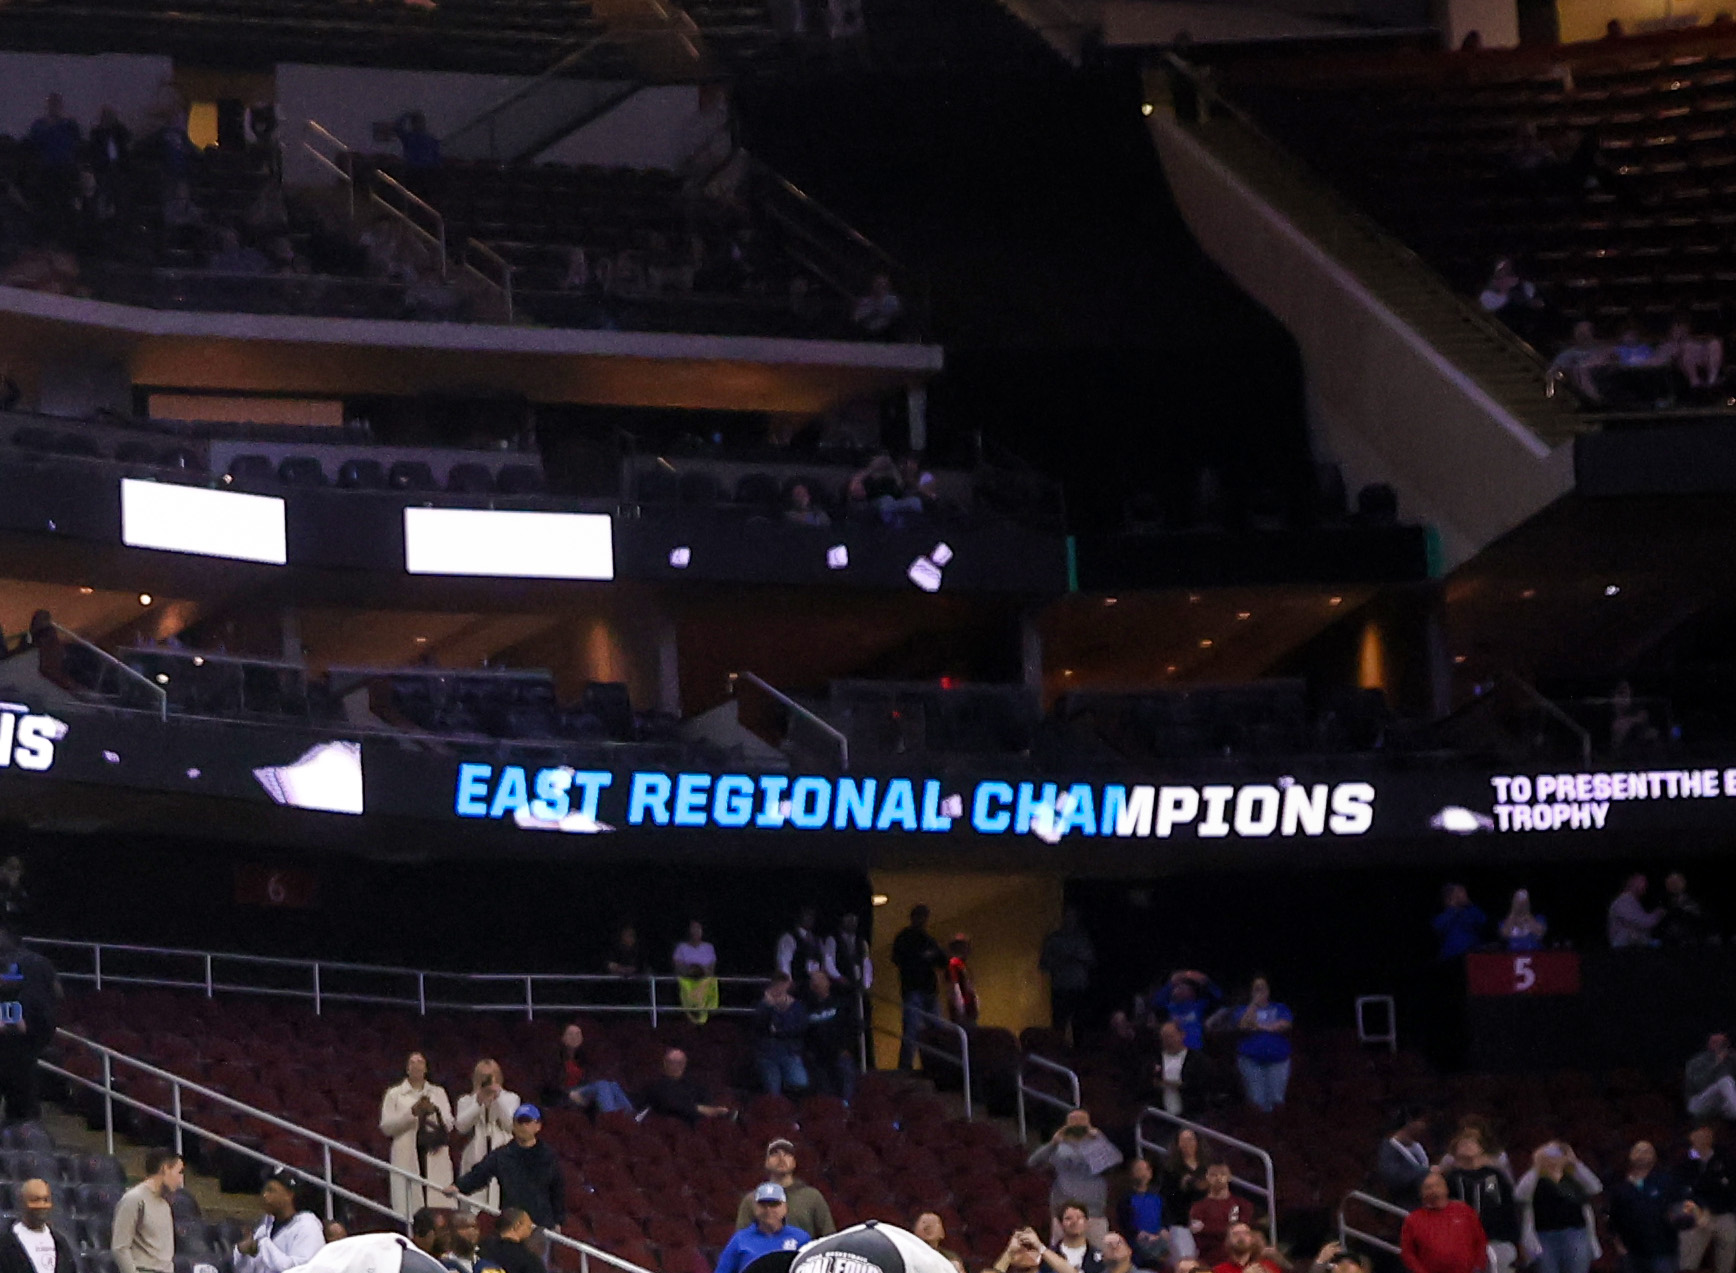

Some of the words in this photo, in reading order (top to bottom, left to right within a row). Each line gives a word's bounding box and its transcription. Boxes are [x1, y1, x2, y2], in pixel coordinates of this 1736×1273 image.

[456, 763, 611, 823] EAST
[627, 770, 951, 832] REGIONAL
[971, 781, 1376, 838] CHAMPIONS
[1491, 775, 1532, 803] TO
[1493, 801, 1610, 832] TROPHY
[1514, 957, 1536, 990] 5
